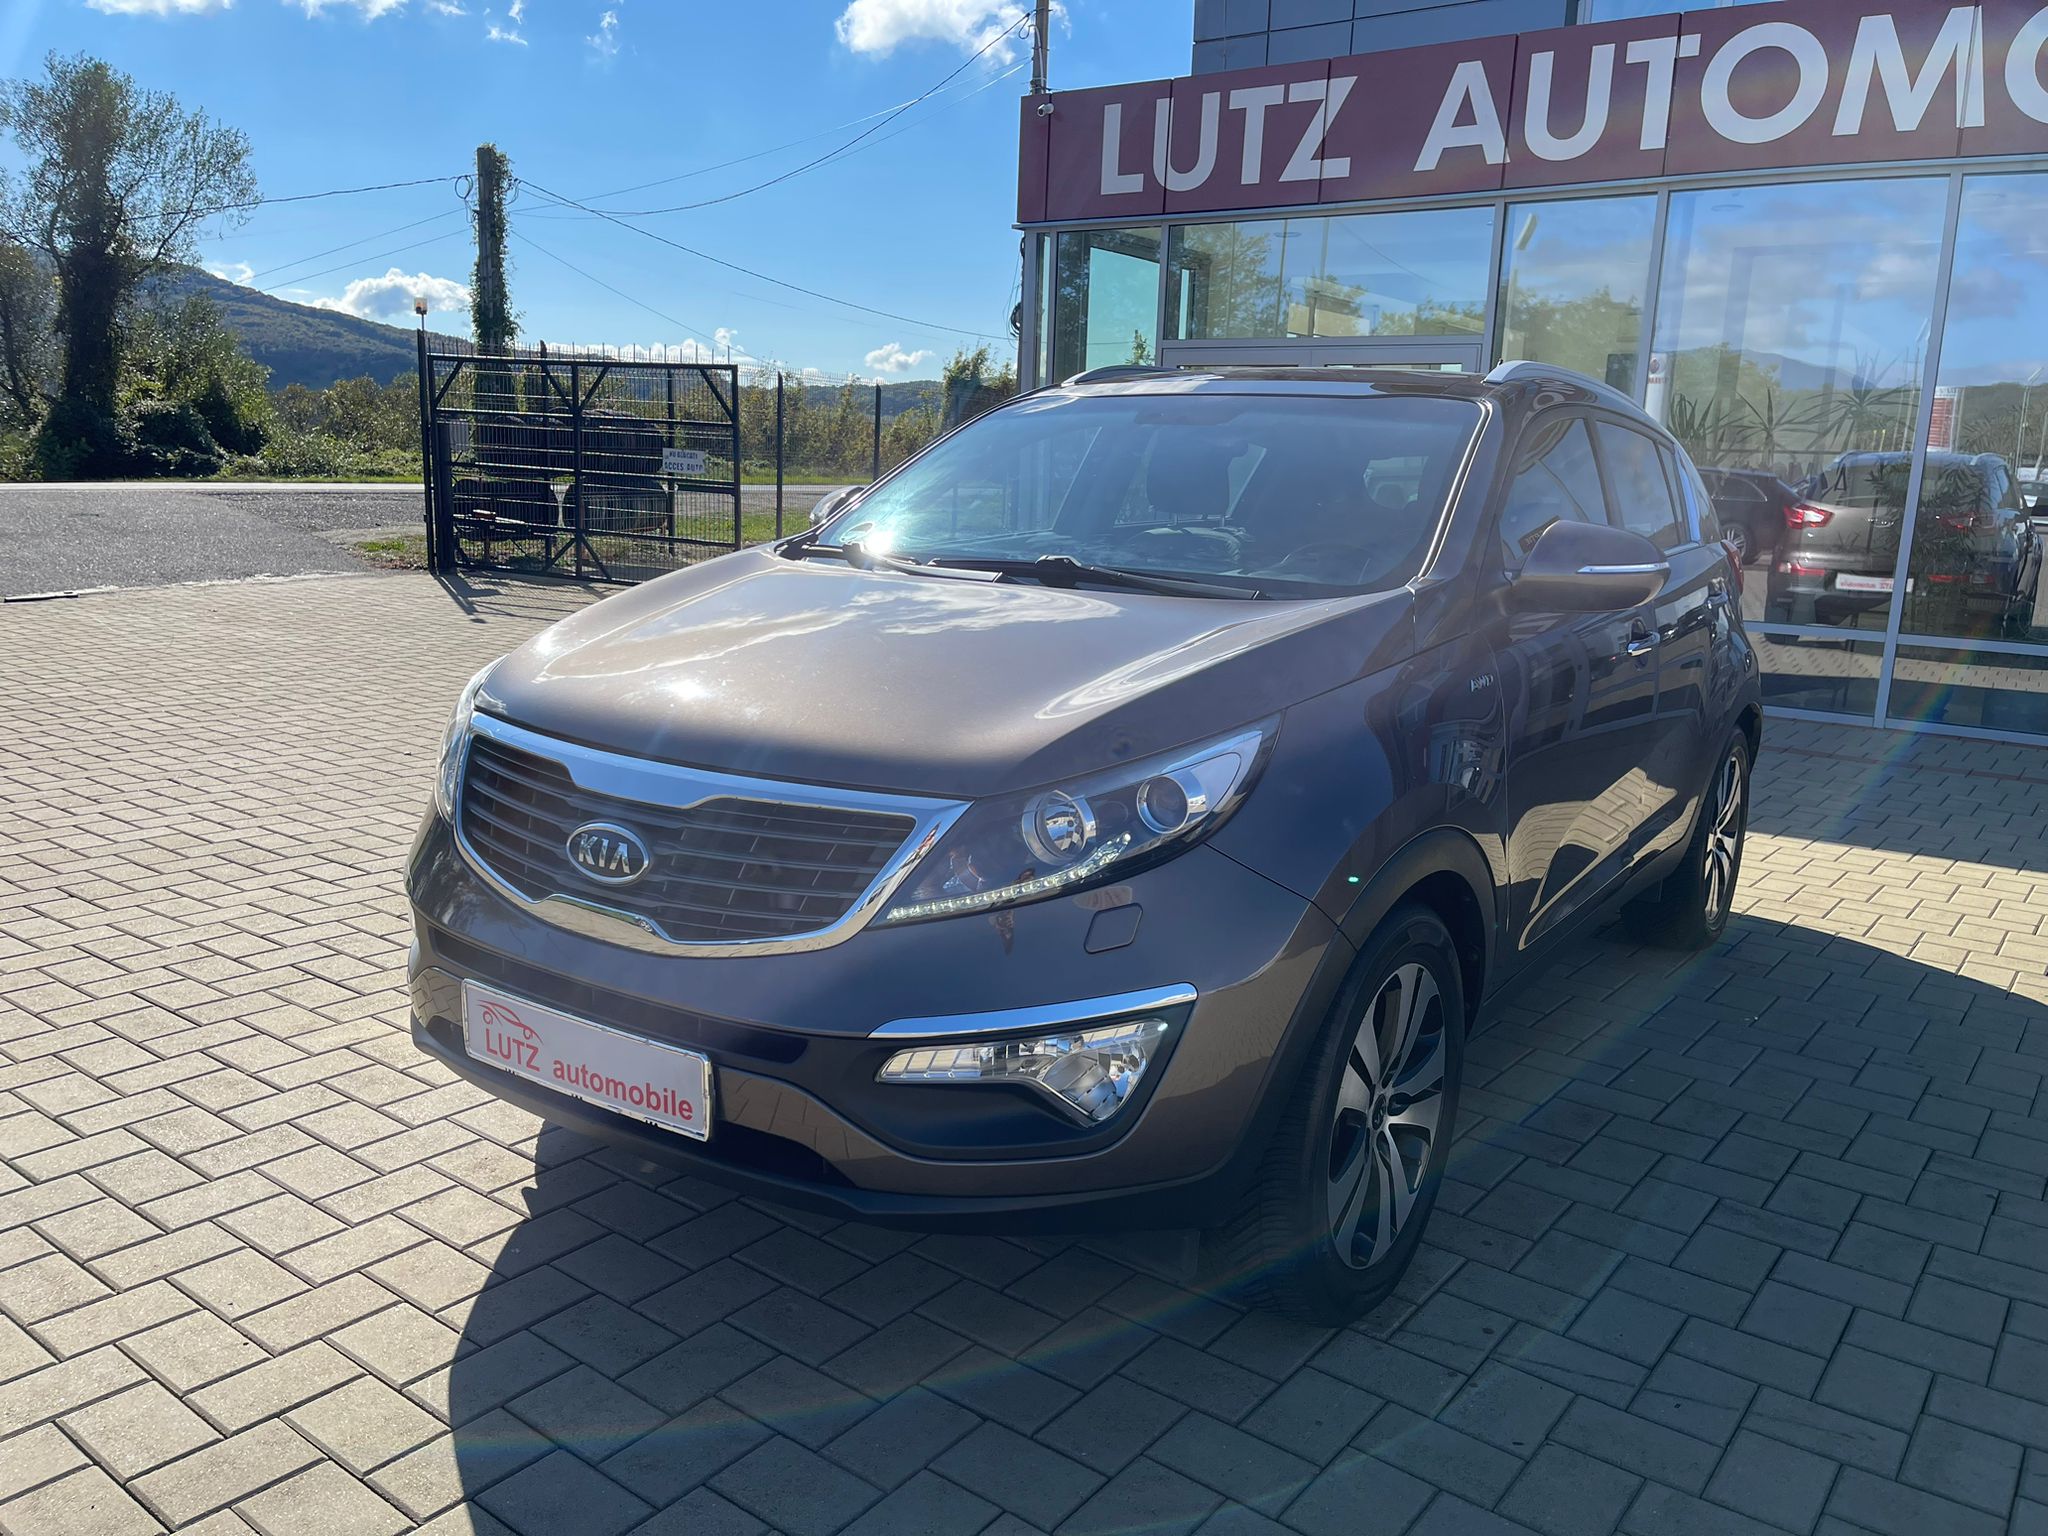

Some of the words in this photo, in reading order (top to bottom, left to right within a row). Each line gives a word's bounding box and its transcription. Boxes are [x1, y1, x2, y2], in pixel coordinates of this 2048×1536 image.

[1100, 75, 1358, 196] LUTZ
[664, 461, 684, 471] ACCES
[578, 832, 631, 874] KIA
[484, 1028, 541, 1072] LUTZ
[552, 1058, 693, 1121] automobile
